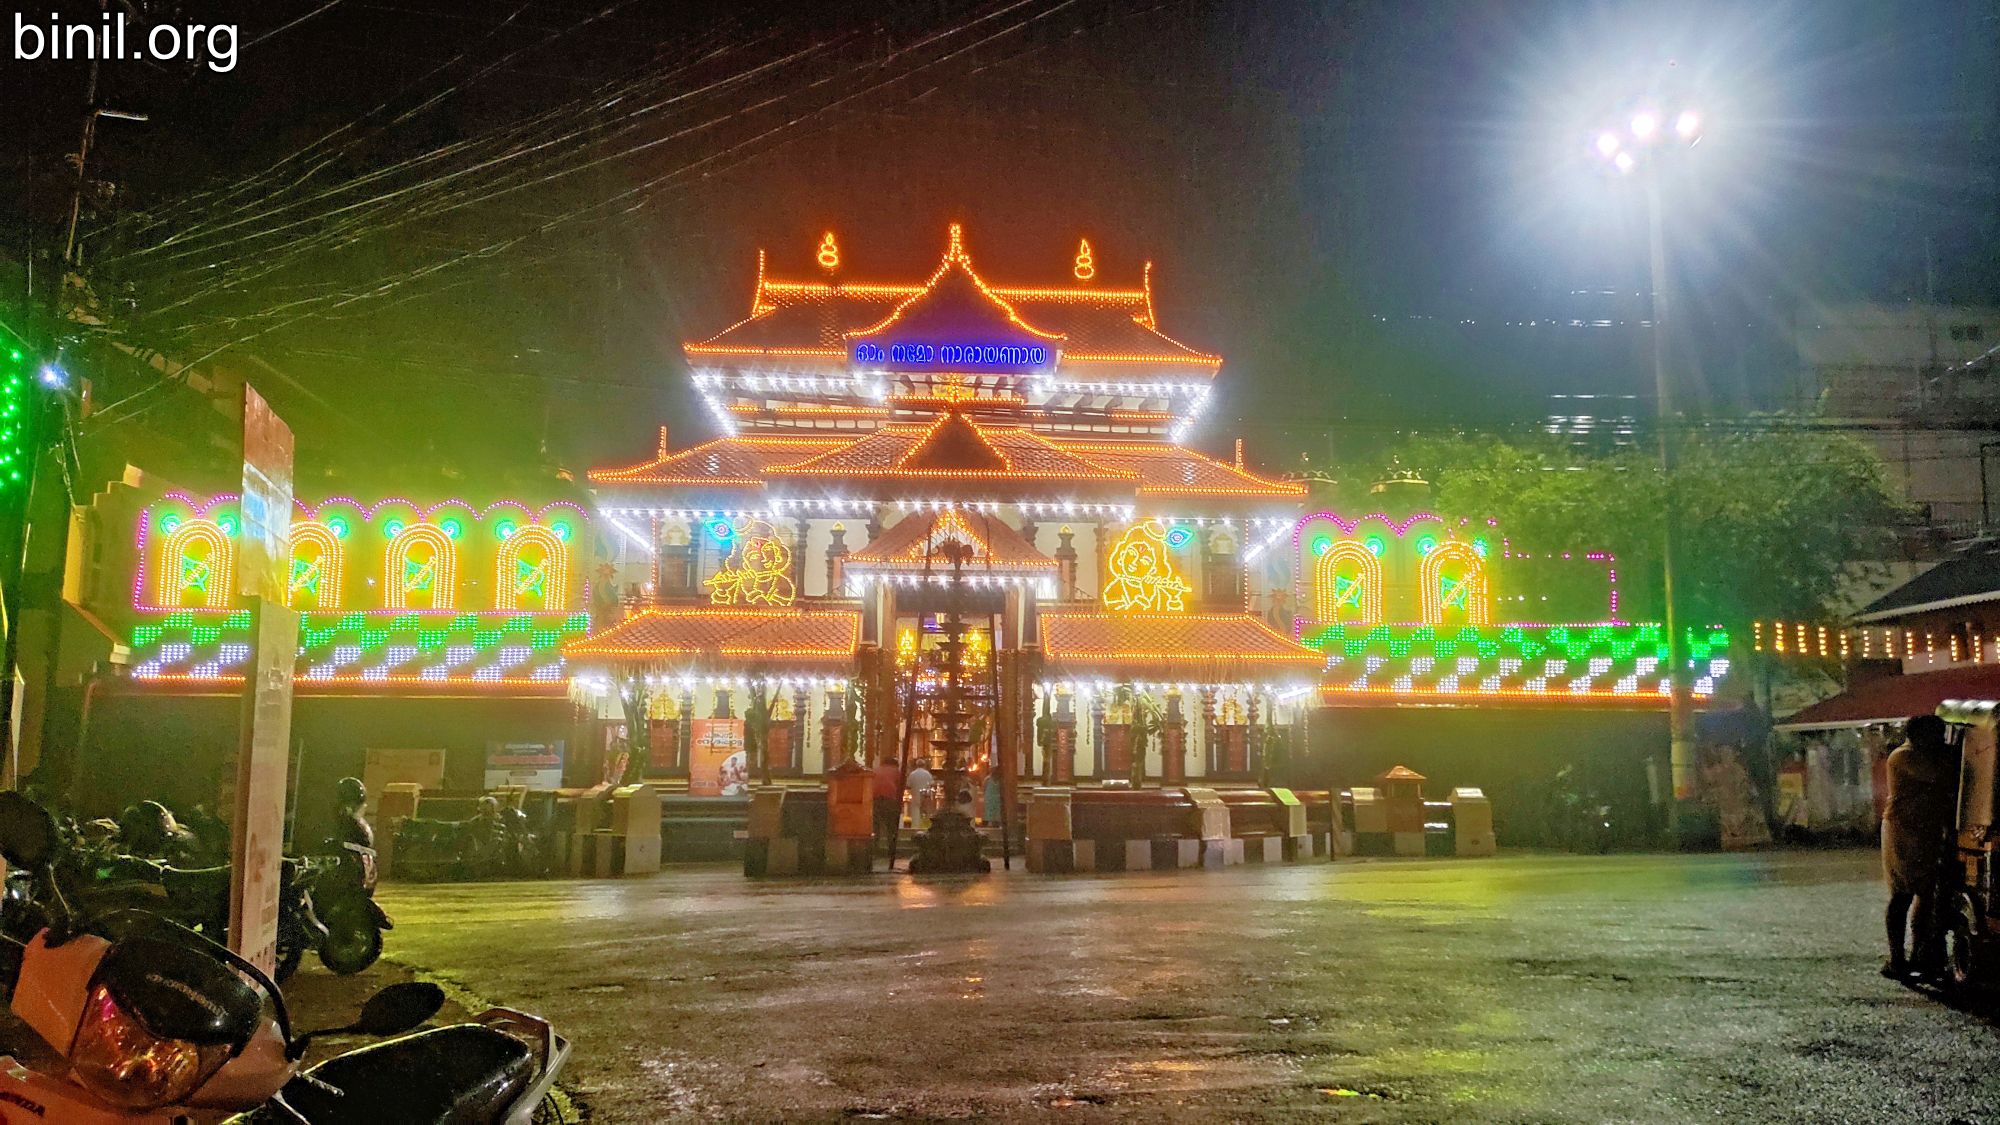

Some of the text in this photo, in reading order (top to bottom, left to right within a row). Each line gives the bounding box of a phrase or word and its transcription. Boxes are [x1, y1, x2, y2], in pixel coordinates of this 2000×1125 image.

[856, 344, 1047, 364] ഓം നമോ നാരായണായ
